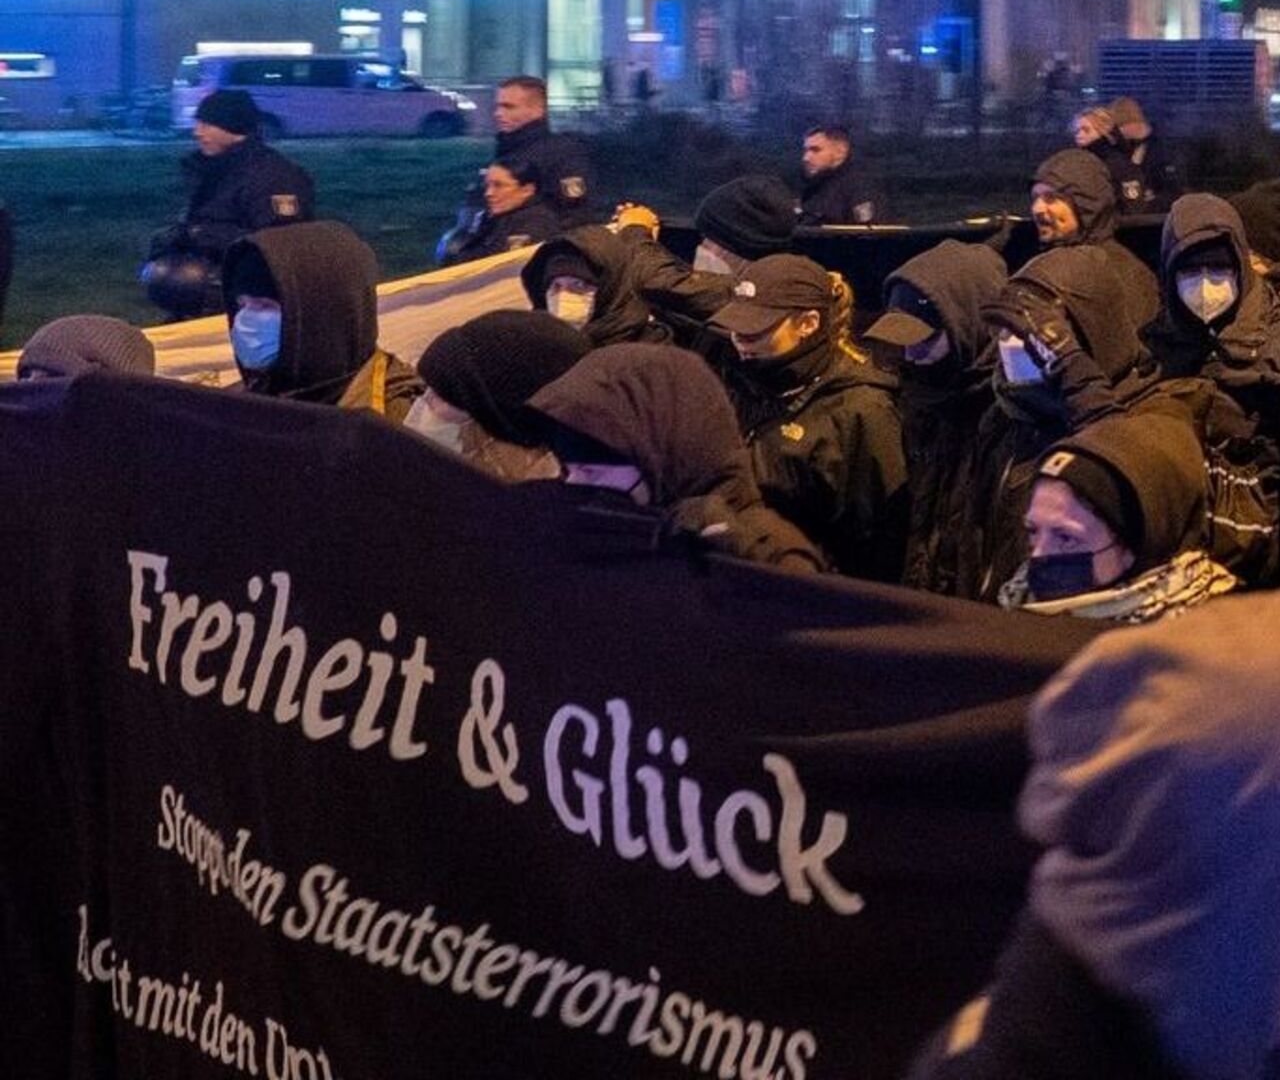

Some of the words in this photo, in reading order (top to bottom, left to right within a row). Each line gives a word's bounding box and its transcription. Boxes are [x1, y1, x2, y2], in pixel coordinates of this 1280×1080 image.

[127, 550, 435, 760] Freiheit
[457, 658, 529, 804] &
[543, 698, 864, 915] Glück
[135, 973, 200, 1041] mit
[199, 980, 259, 1076] den
[227, 827, 287, 926] den
[281, 863, 817, 1080] Staatsterrorismus
